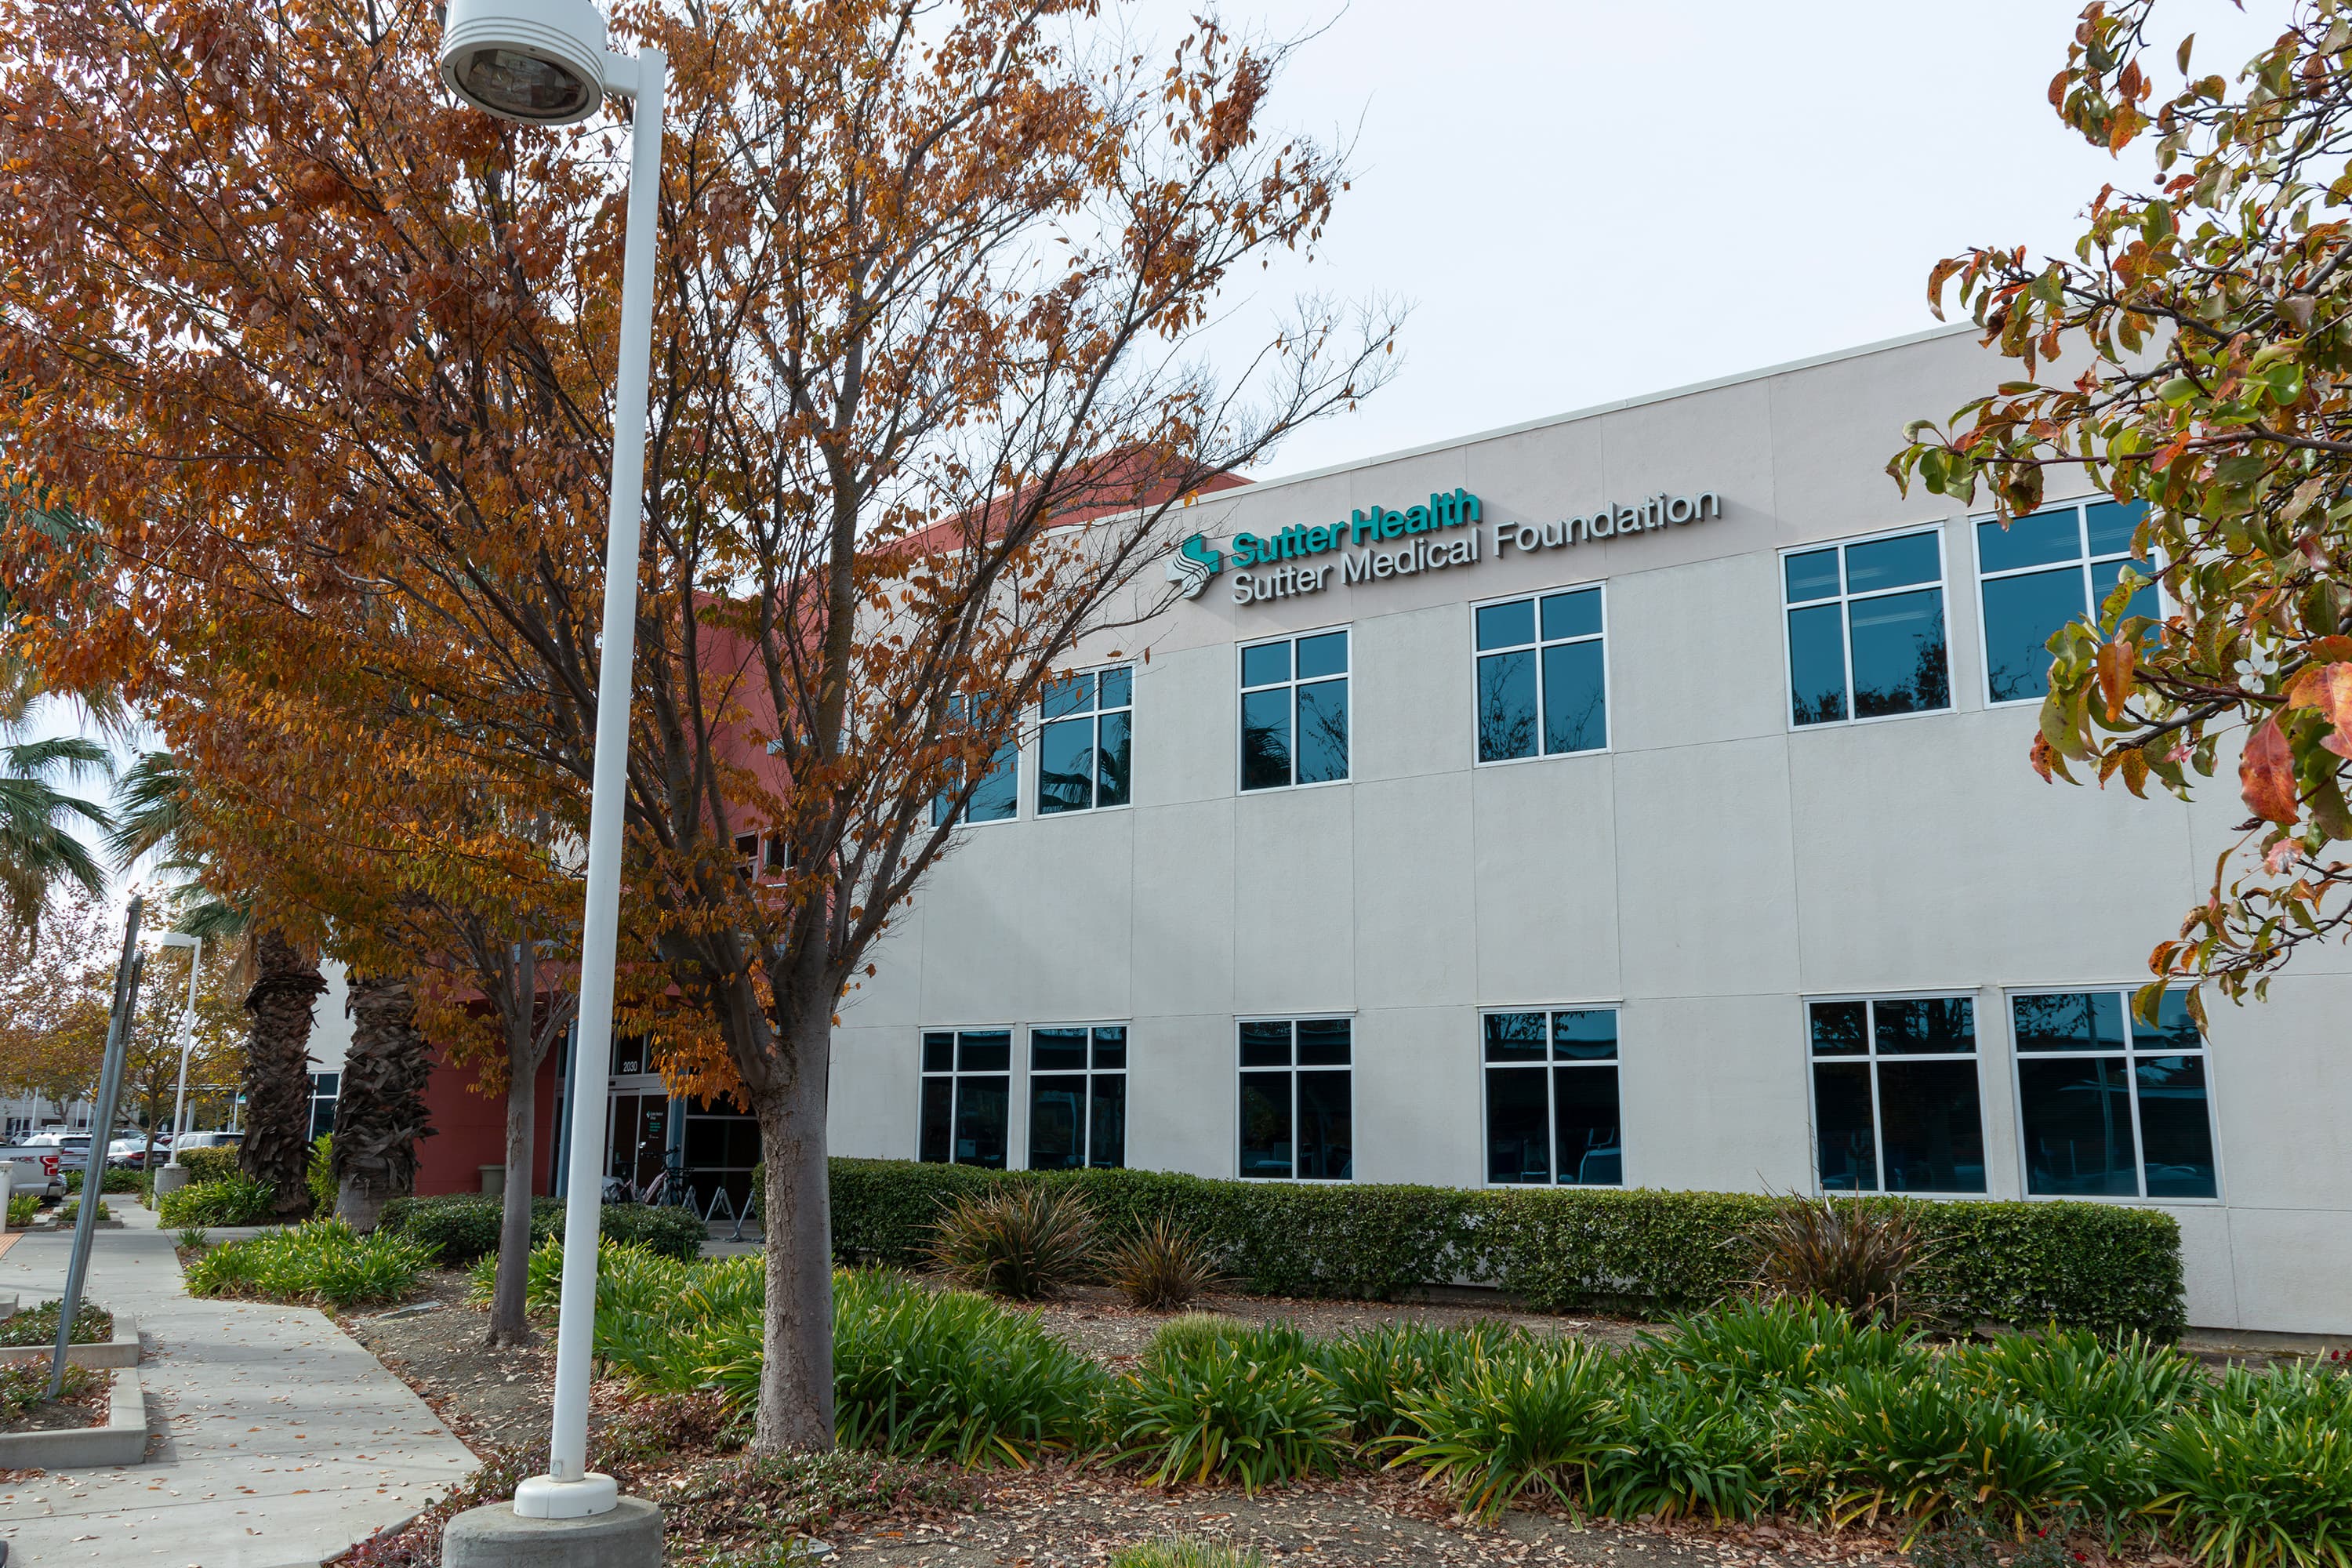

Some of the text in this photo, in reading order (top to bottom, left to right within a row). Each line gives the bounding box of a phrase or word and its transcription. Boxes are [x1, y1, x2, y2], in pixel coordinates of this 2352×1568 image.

[1231, 490, 1721, 605] Sutter Medical Foundation
[1232, 488, 1483, 569] Sutter Health
[623, 1061, 637, 1073] 2030
